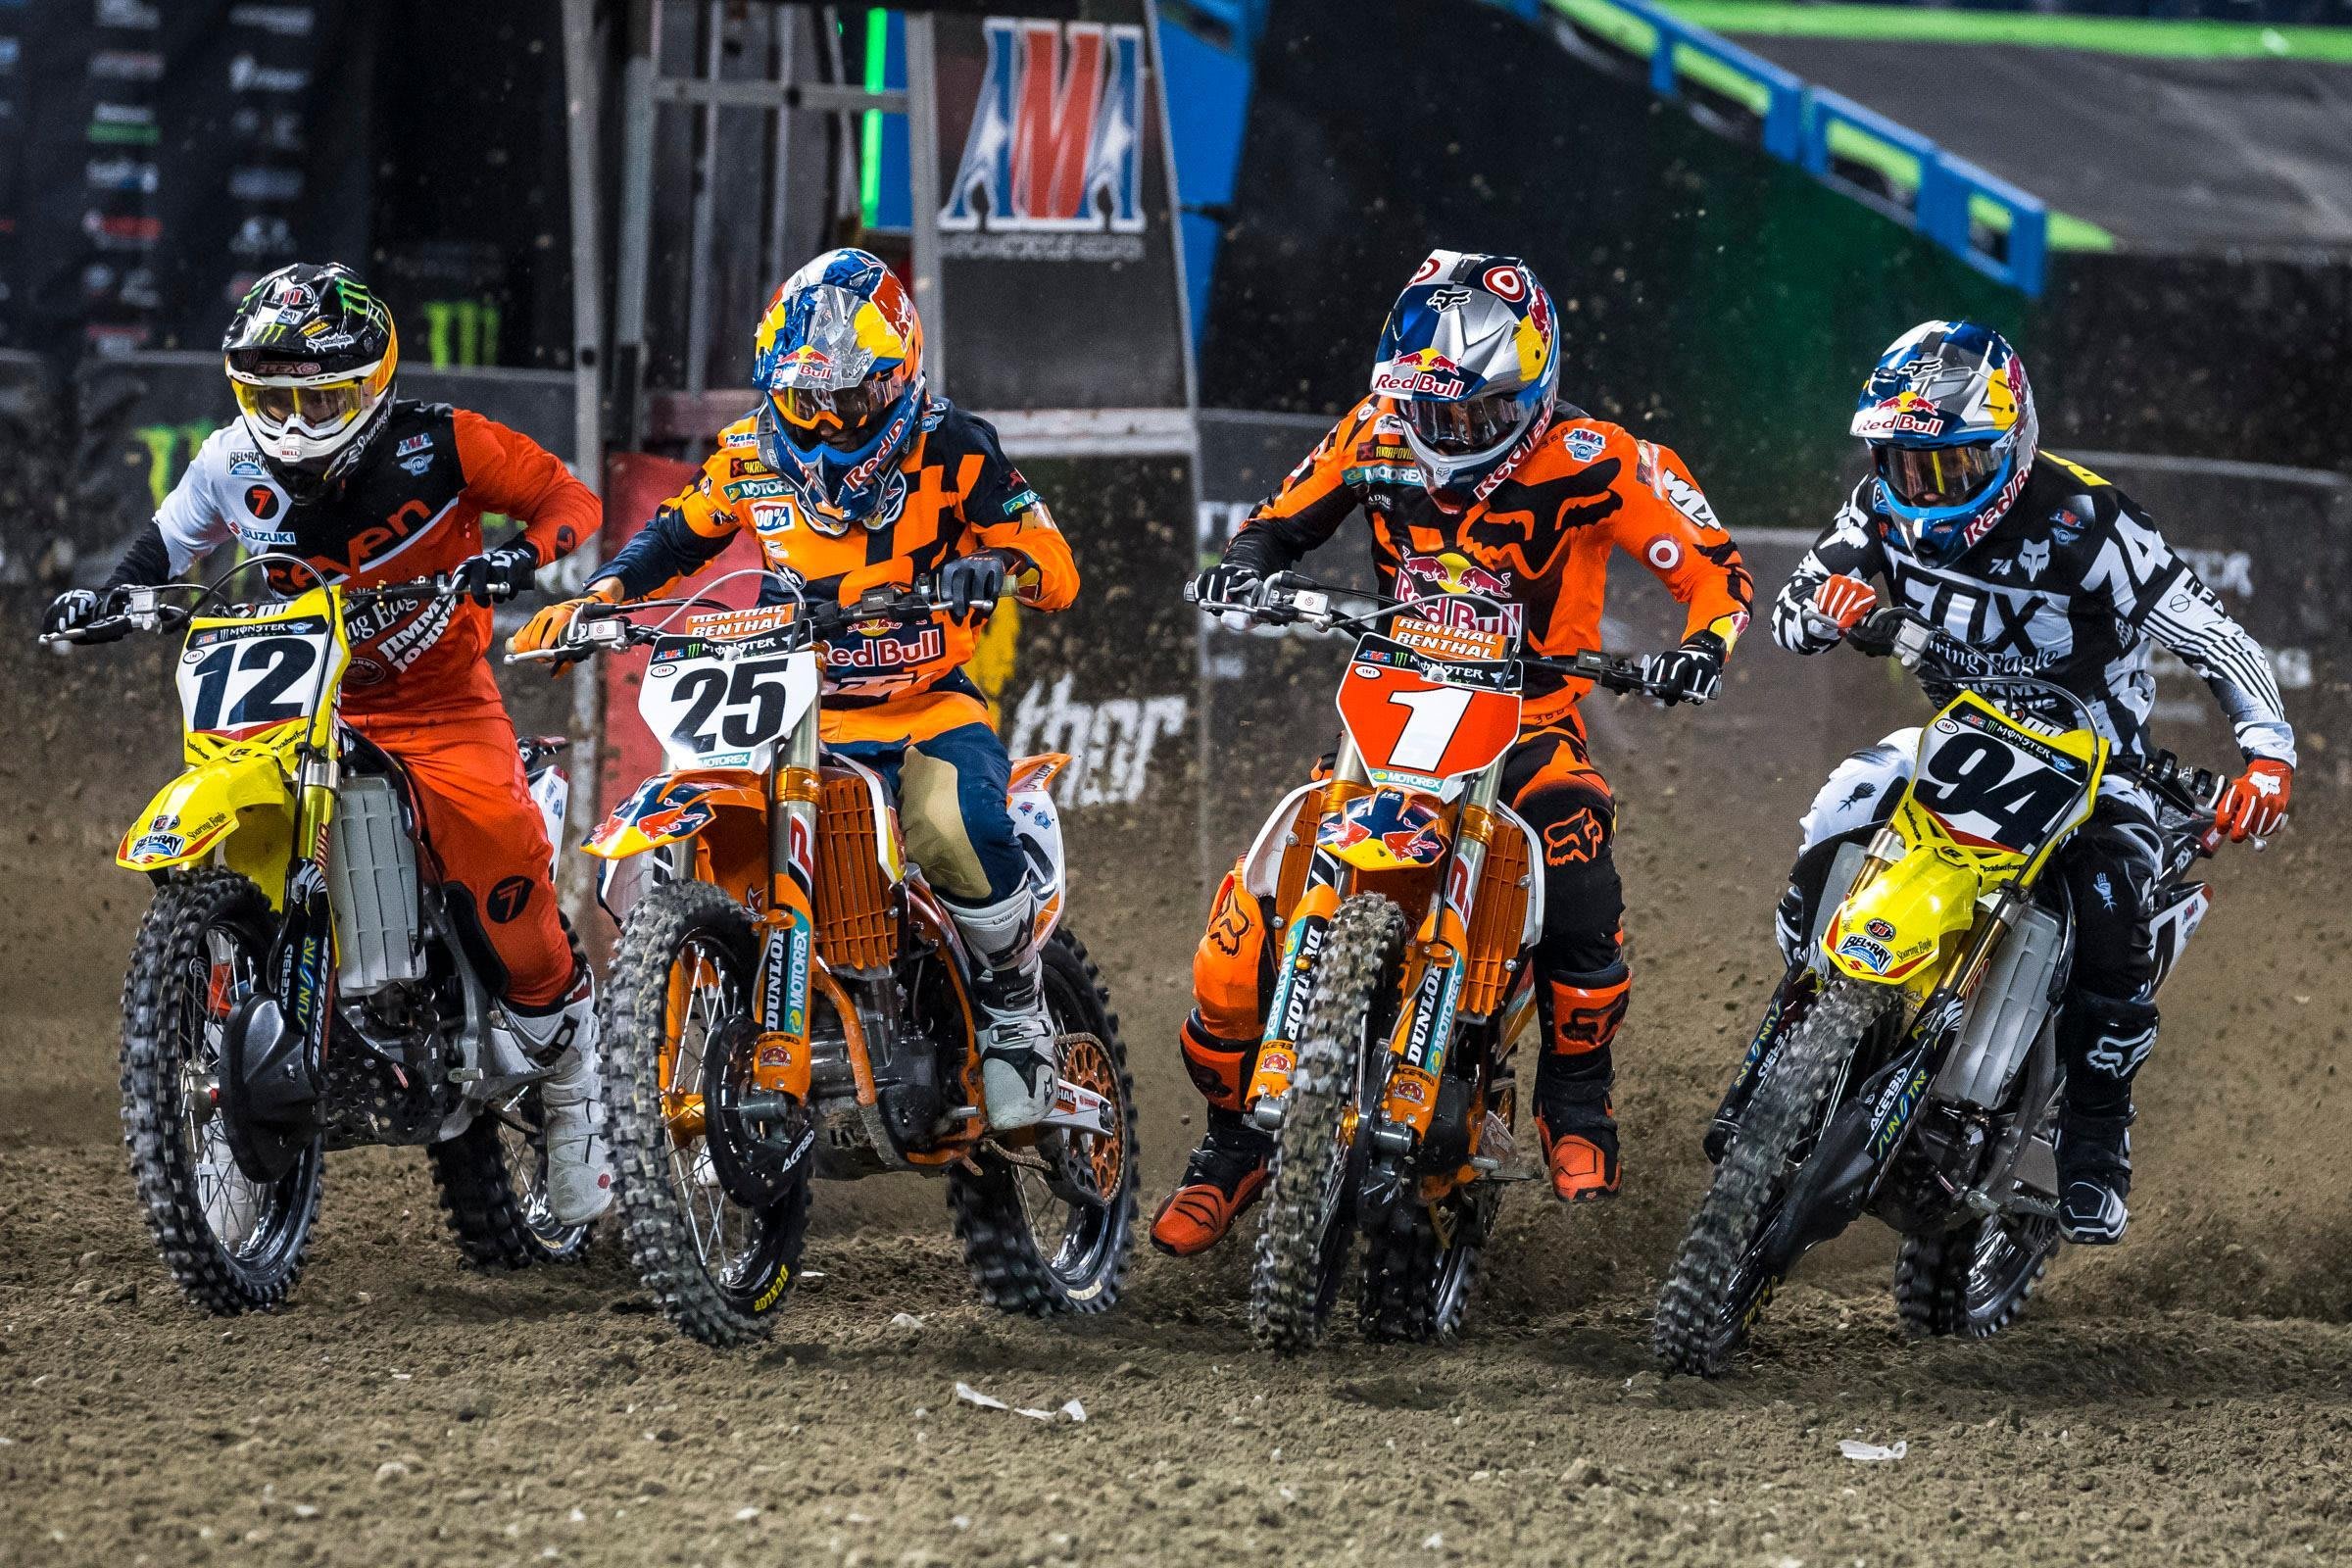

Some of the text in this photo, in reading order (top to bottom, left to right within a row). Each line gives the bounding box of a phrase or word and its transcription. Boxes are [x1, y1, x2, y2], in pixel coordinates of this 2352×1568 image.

[938, 18, 1145, 230] AMA
[799, 364, 832, 380] Bull
[1374, 372, 1464, 400] Red Bull
[1568, 429, 1605, 447] AMA
[1898, 415, 1944, 437] Bull
[397, 433, 433, 457] AMA
[252, 488, 272, 516] 7
[242, 529, 295, 543] SUZUKI
[230, 623, 286, 636] MONSTER
[691, 616, 786, 638] RENTHAL
[1398, 617, 1497, 645] RENTHAL
[1449, 600, 1523, 638] Bull
[878, 628, 941, 665] Bull
[1358, 649, 1392, 663] AMA
[1395, 630, 1495, 661] RENTHAL
[193, 638, 317, 730] 12
[670, 660, 788, 754] 25
[1388, 686, 1475, 773] 1
[1996, 725, 2052, 760] MONSTER
[699, 754, 749, 768] MOTOREX
[1388, 772, 1441, 789] MOTOREX
[1913, 731, 2081, 860] 94
[789, 928, 808, 1009] MOTOREX
